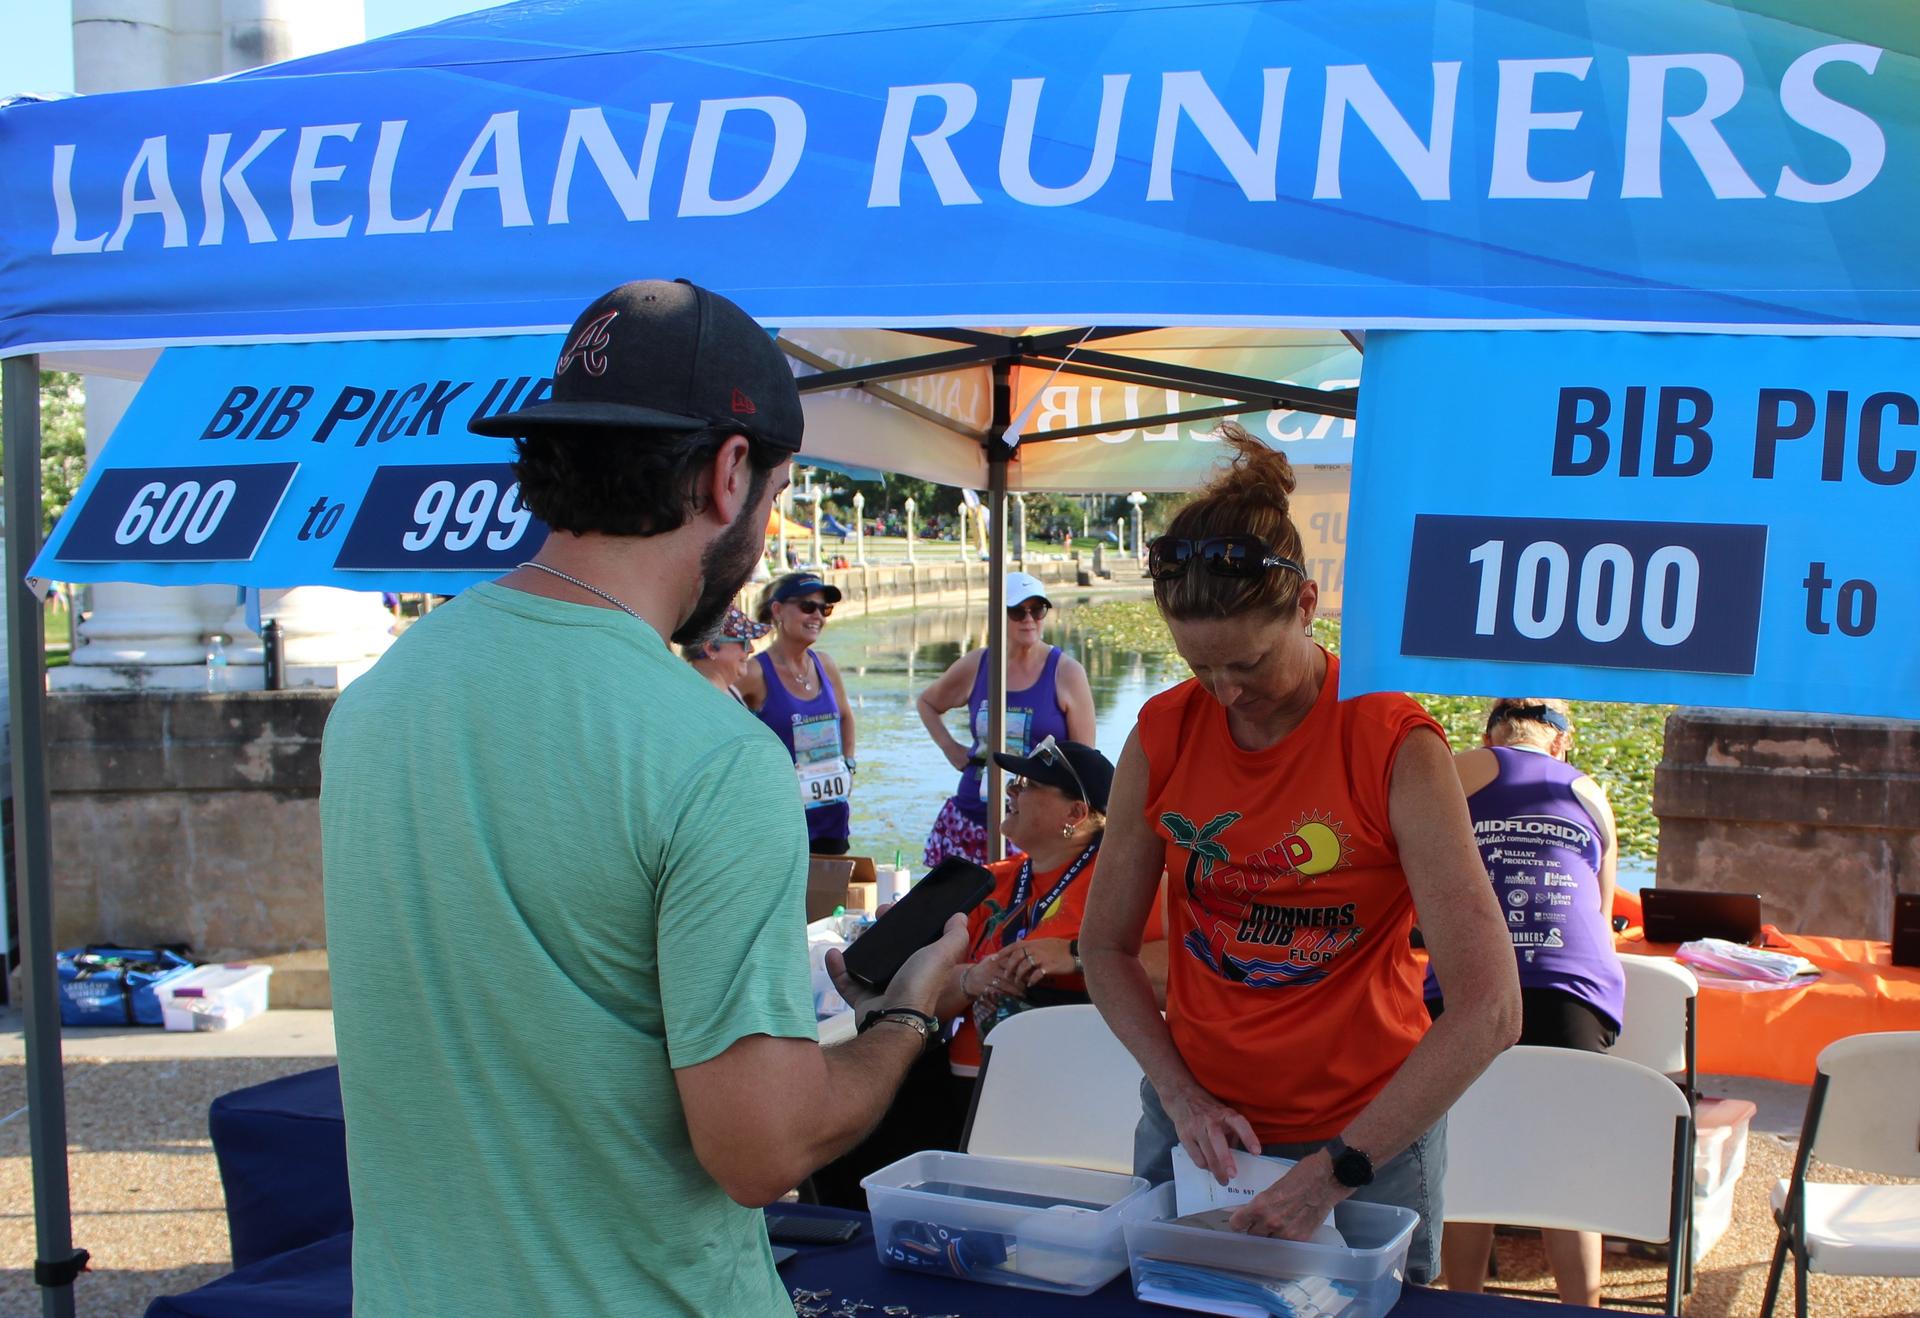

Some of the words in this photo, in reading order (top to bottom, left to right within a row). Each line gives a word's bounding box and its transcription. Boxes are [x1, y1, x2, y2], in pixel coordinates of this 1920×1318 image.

[51, 95, 807, 255] LAKELAND
[867, 43, 1886, 208] RUNNERS
[200, 385, 314, 441] BIB
[313, 379, 475, 447] PICK
[1551, 386, 1713, 477] BIB
[1752, 388, 1919, 485] PIC
[114, 480, 237, 545] 600
[299, 497, 345, 541] to
[402, 480, 532, 551] 999
[1469, 539, 1700, 646] 1000
[1803, 562, 1877, 637] to
[811, 776, 844, 800] 940
[1507, 836, 1544, 845] community
[1545, 839, 1564, 848] credit
[1564, 843, 1581, 853] union
[1039, 845, 1096, 909] VOLUNTEER
[1237, 919, 1295, 947] CLUB
[1250, 903, 1356, 927] RUNNERS
[1511, 932, 1544, 942] UNNERS
